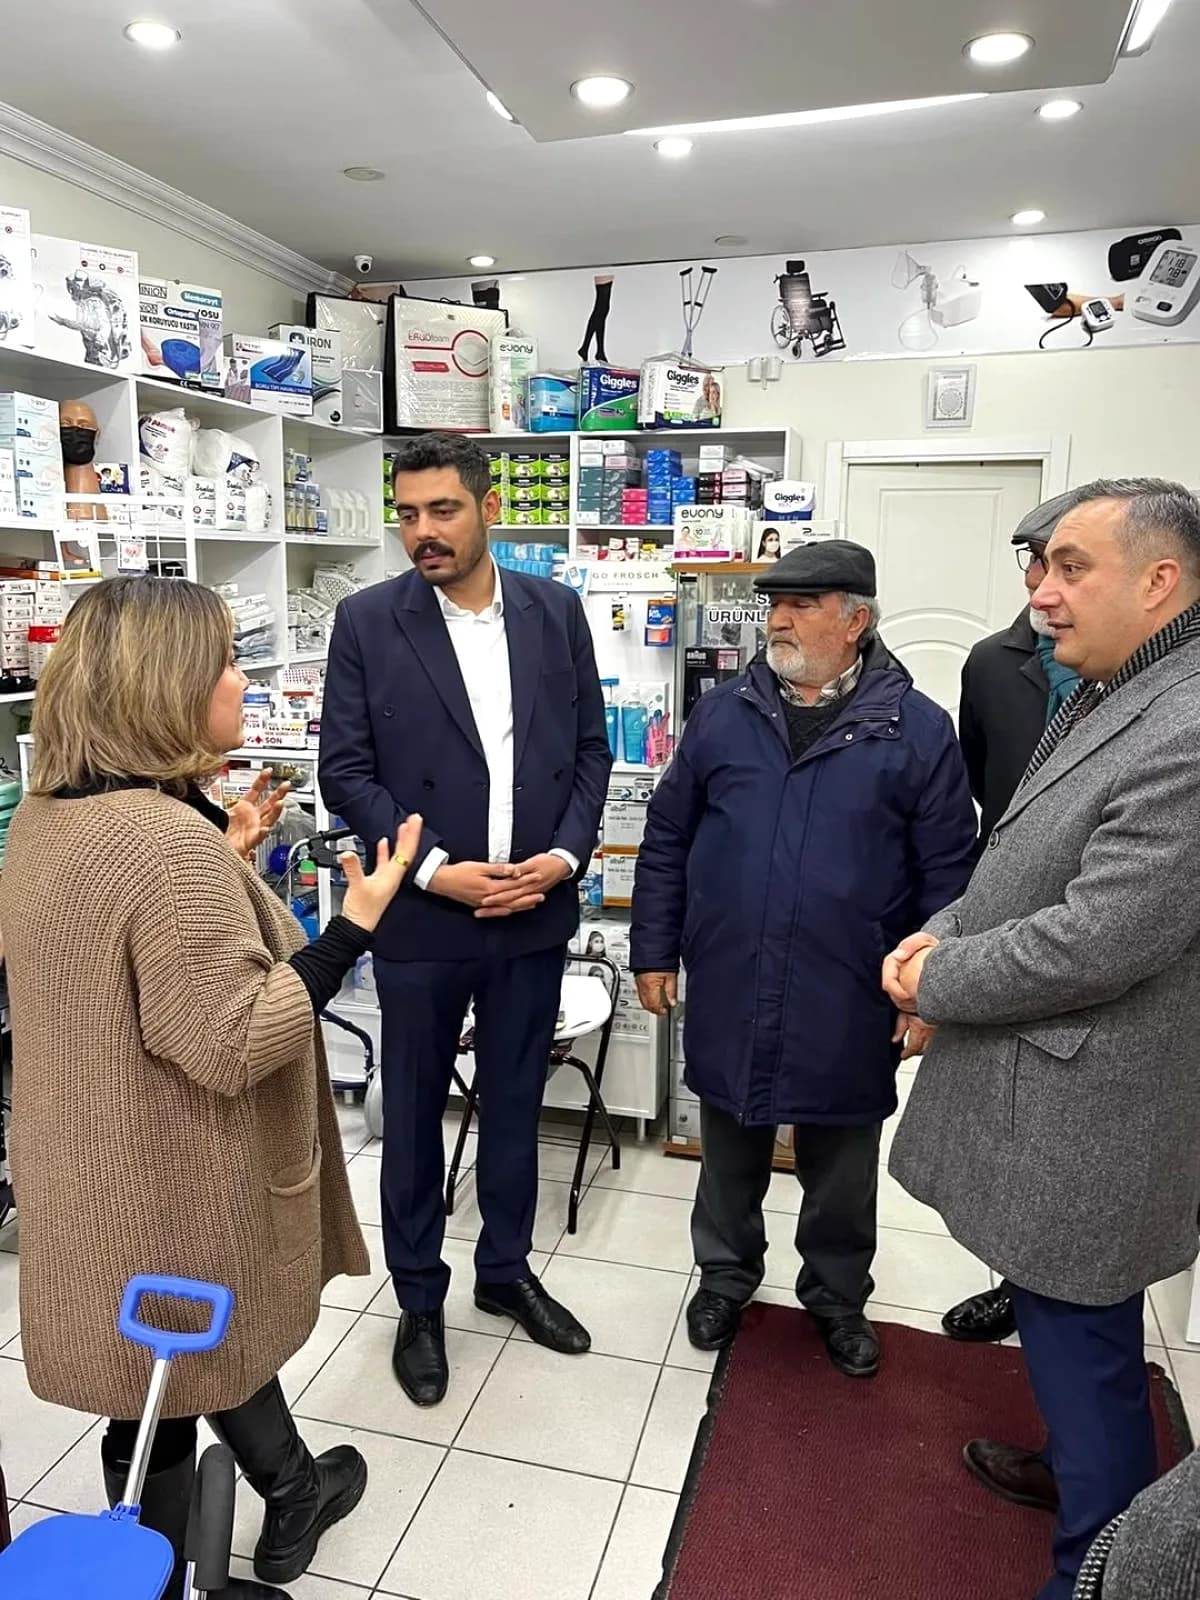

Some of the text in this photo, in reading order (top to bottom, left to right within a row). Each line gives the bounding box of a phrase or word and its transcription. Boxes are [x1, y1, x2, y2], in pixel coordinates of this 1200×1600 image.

[198, 309, 220, 320] OSU
[307, 336, 332, 349] IRON
[600, 373, 638, 390] Giggles
[666, 369, 700, 386] Giggles
[774, 492, 805, 503] Giggles
[681, 508, 724, 518] evony
[757, 594, 771, 605] S
[708, 606, 770, 623] ÜRÜNL
